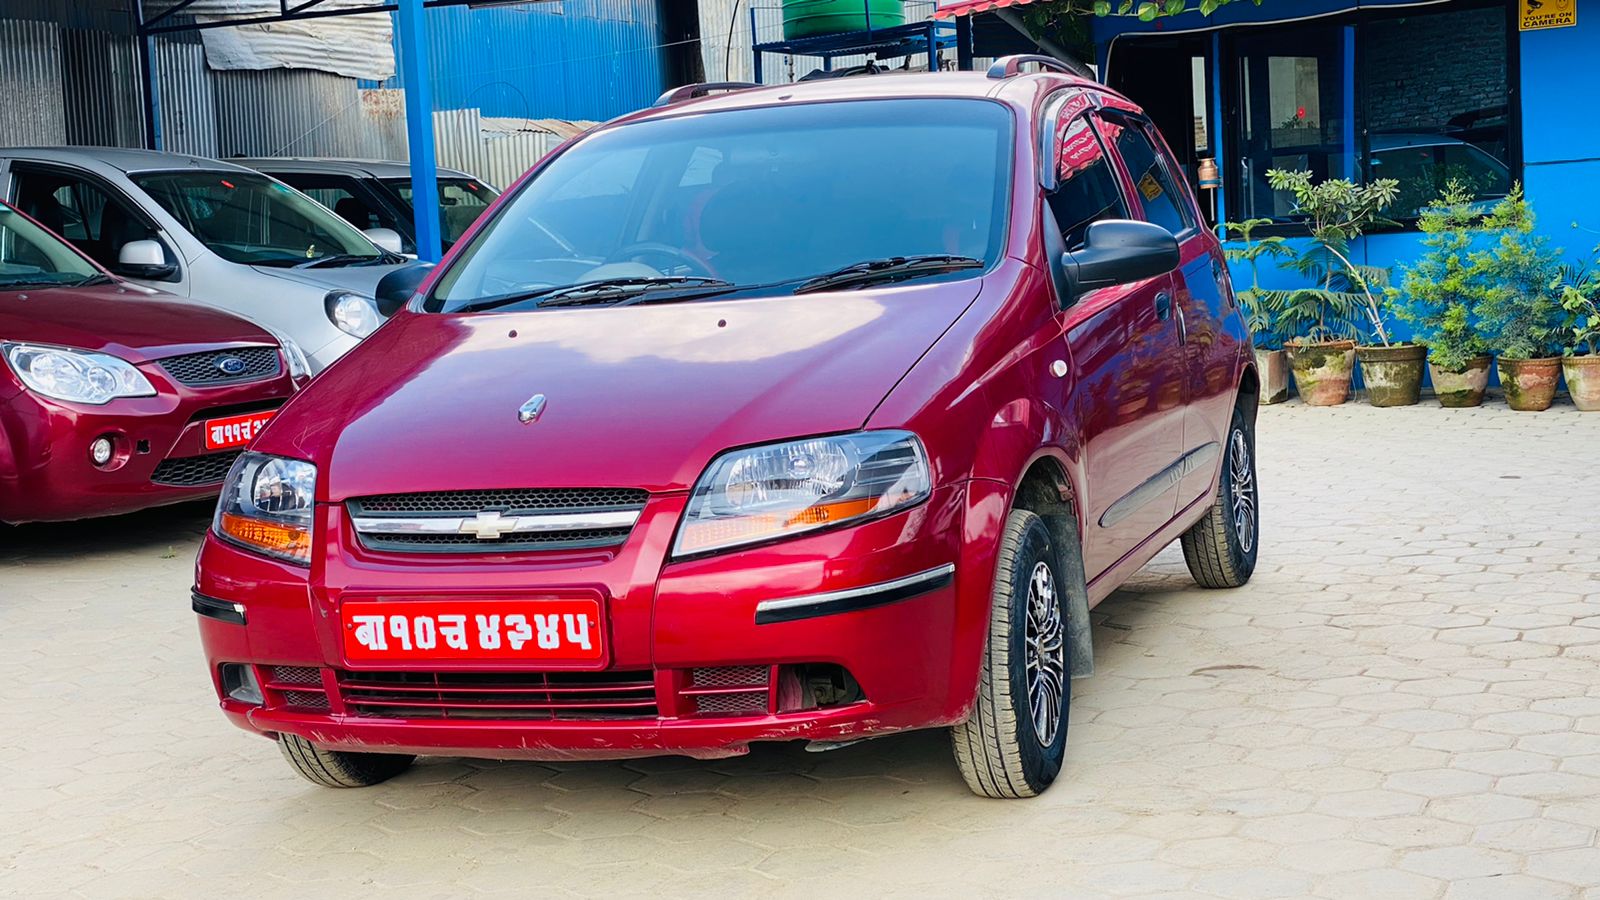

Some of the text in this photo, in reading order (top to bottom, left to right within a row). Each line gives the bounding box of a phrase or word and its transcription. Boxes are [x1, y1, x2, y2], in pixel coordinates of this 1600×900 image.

[1523, 17, 1571, 27] CAMERA
[1524, 13, 1556, 21] YOU'RE
[474, 613, 592, 650] ४३४५
